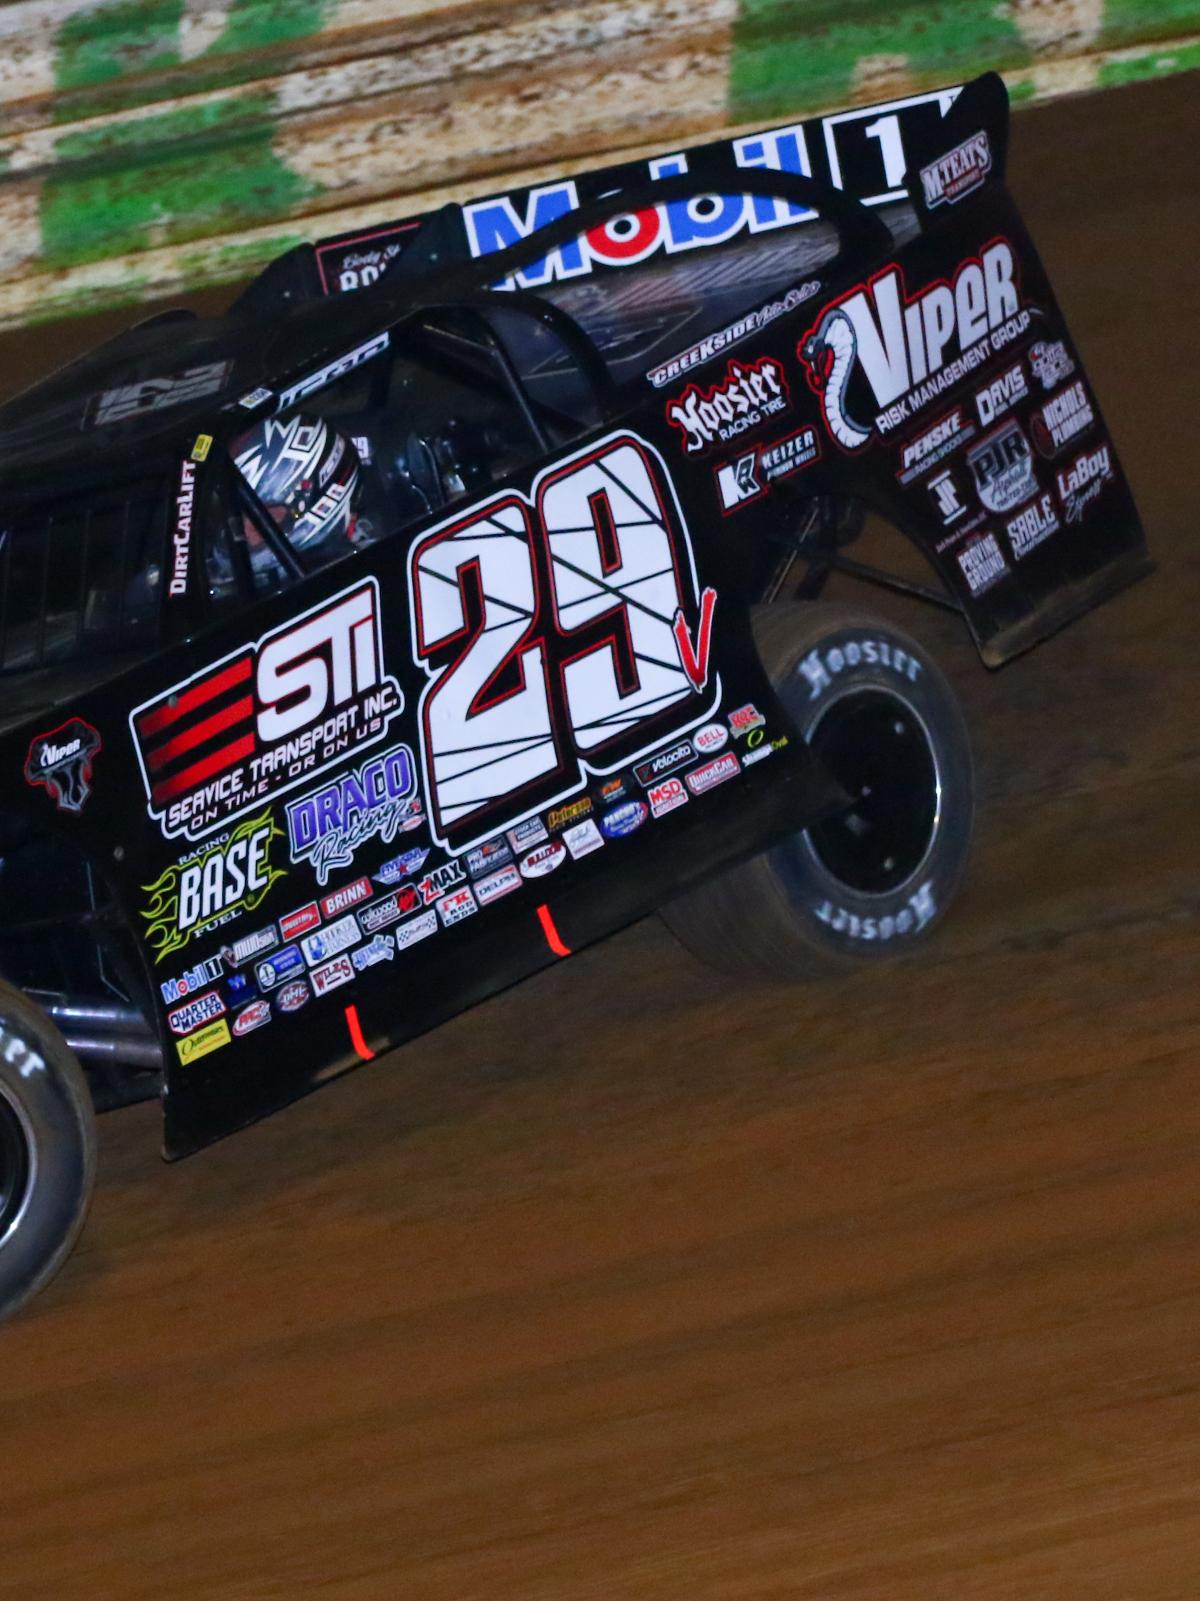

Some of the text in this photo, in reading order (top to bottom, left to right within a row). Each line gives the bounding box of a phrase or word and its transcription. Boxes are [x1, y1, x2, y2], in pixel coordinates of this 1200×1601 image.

[463, 115, 907, 292] Mobil 1
[654, 315, 758, 385] CREEKSIDE
[875, 402, 912, 435] RISK
[909, 343, 992, 411] MANAGEMENT
[991, 310, 1031, 350] GROUP
[672, 364, 781, 452] Hoosier
[719, 396, 787, 440] RACING TIRE
[976, 365, 1025, 427] DAVIS
[761, 430, 814, 468] KEIZER
[903, 411, 962, 468] PENSKE
[1057, 447, 1111, 500] LaBoy
[1007, 495, 1056, 549] SABLE
[168, 685, 398, 829] SERVICE TRANSPORT INC.
[697, 727, 725, 747] BELL
[190, 808, 218, 831] ON
[223, 780, 270, 814] TIME
[288, 753, 317, 778] OR
[322, 734, 349, 757] ON
[355, 717, 382, 740] US
[290, 749, 411, 849] DRACO
[650, 780, 681, 805] MSD
[178, 832, 231, 866] RACING
[316, 799, 406, 882] Racing
[178, 827, 270, 931] BASE
[326, 882, 367, 914] BRINN
[194, 910, 243, 938] FUEL
[160, 964, 208, 1005] Mobil
[170, 994, 218, 1028] QUARTER
[181, 1005, 223, 1031] MASTER
